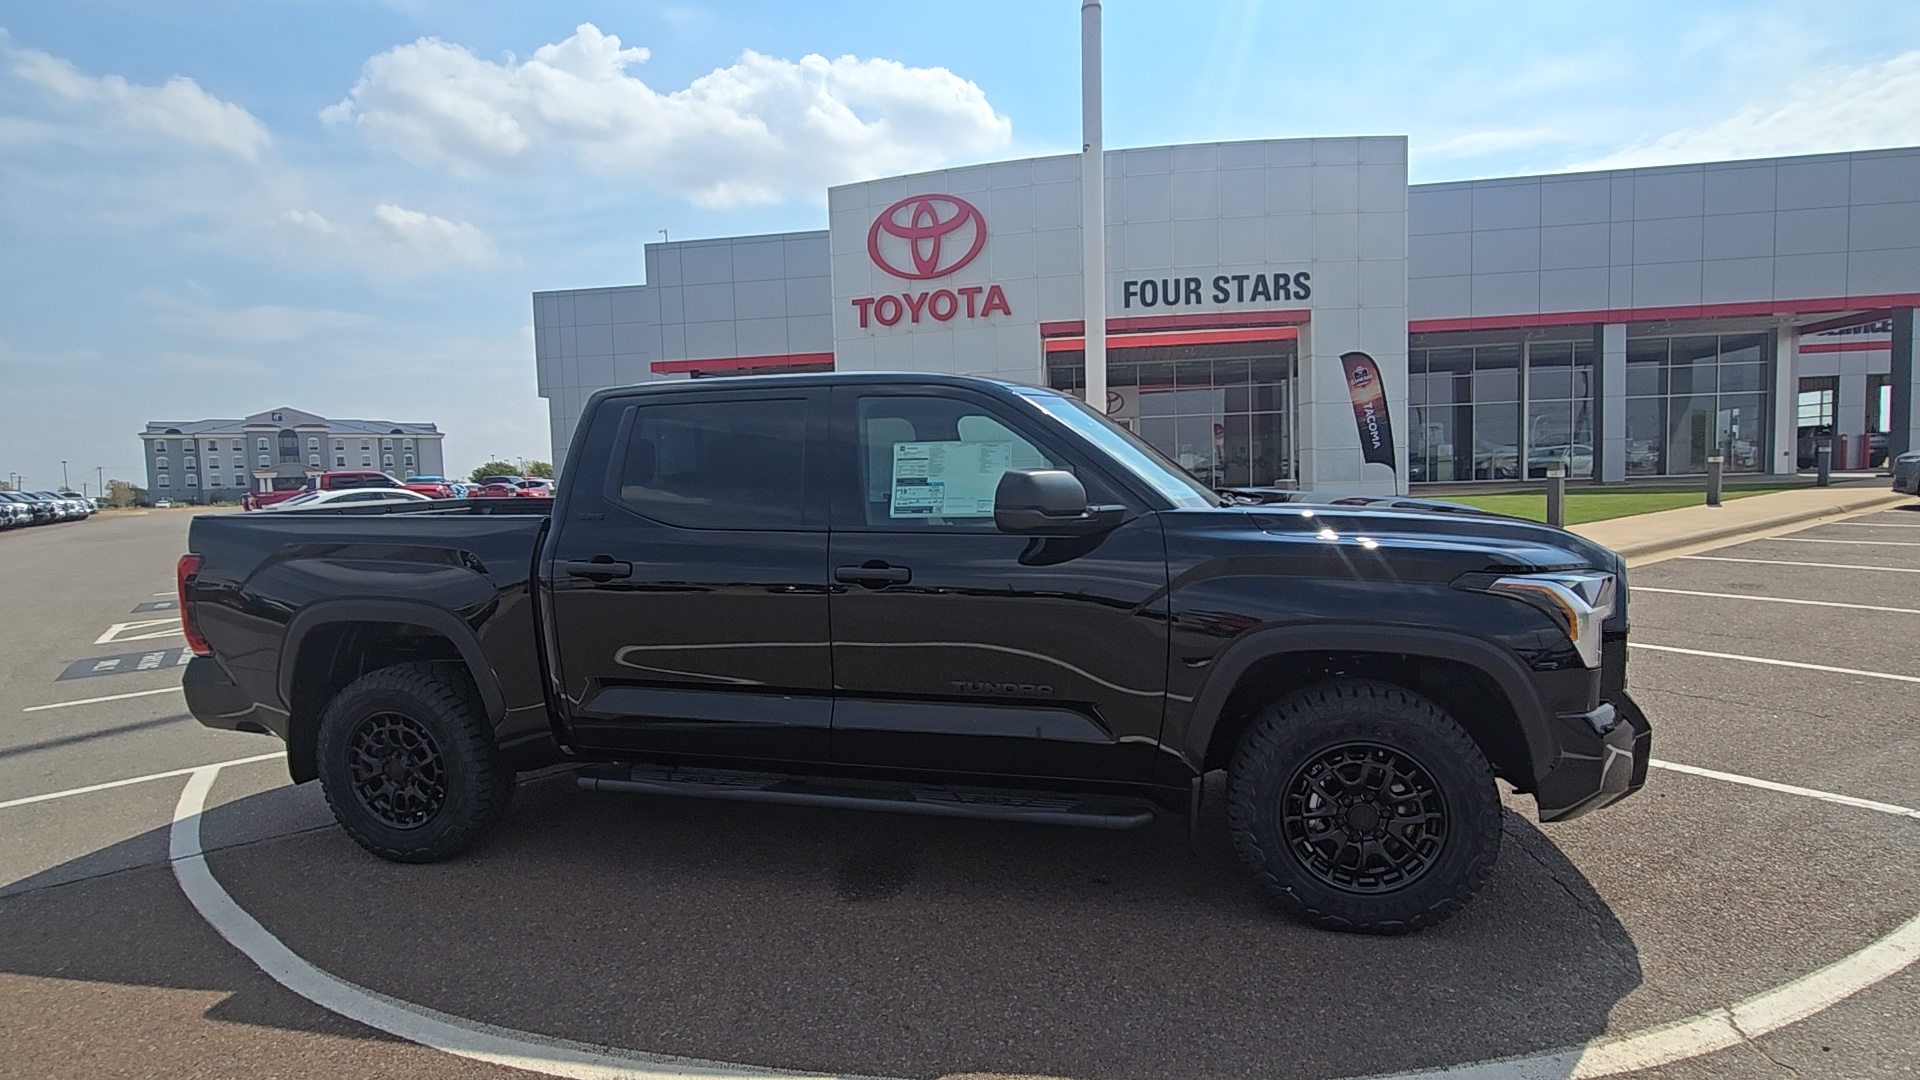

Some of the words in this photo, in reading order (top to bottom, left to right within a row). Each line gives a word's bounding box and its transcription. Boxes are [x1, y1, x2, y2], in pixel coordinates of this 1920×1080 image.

[851, 284, 1012, 328] TOYOTA
[1123, 277, 1202, 308] FOUR
[1212, 271, 1311, 304] STARS
[1363, 401, 1381, 450] TACOMA
[950, 681, 1055, 697] TUNDRA
